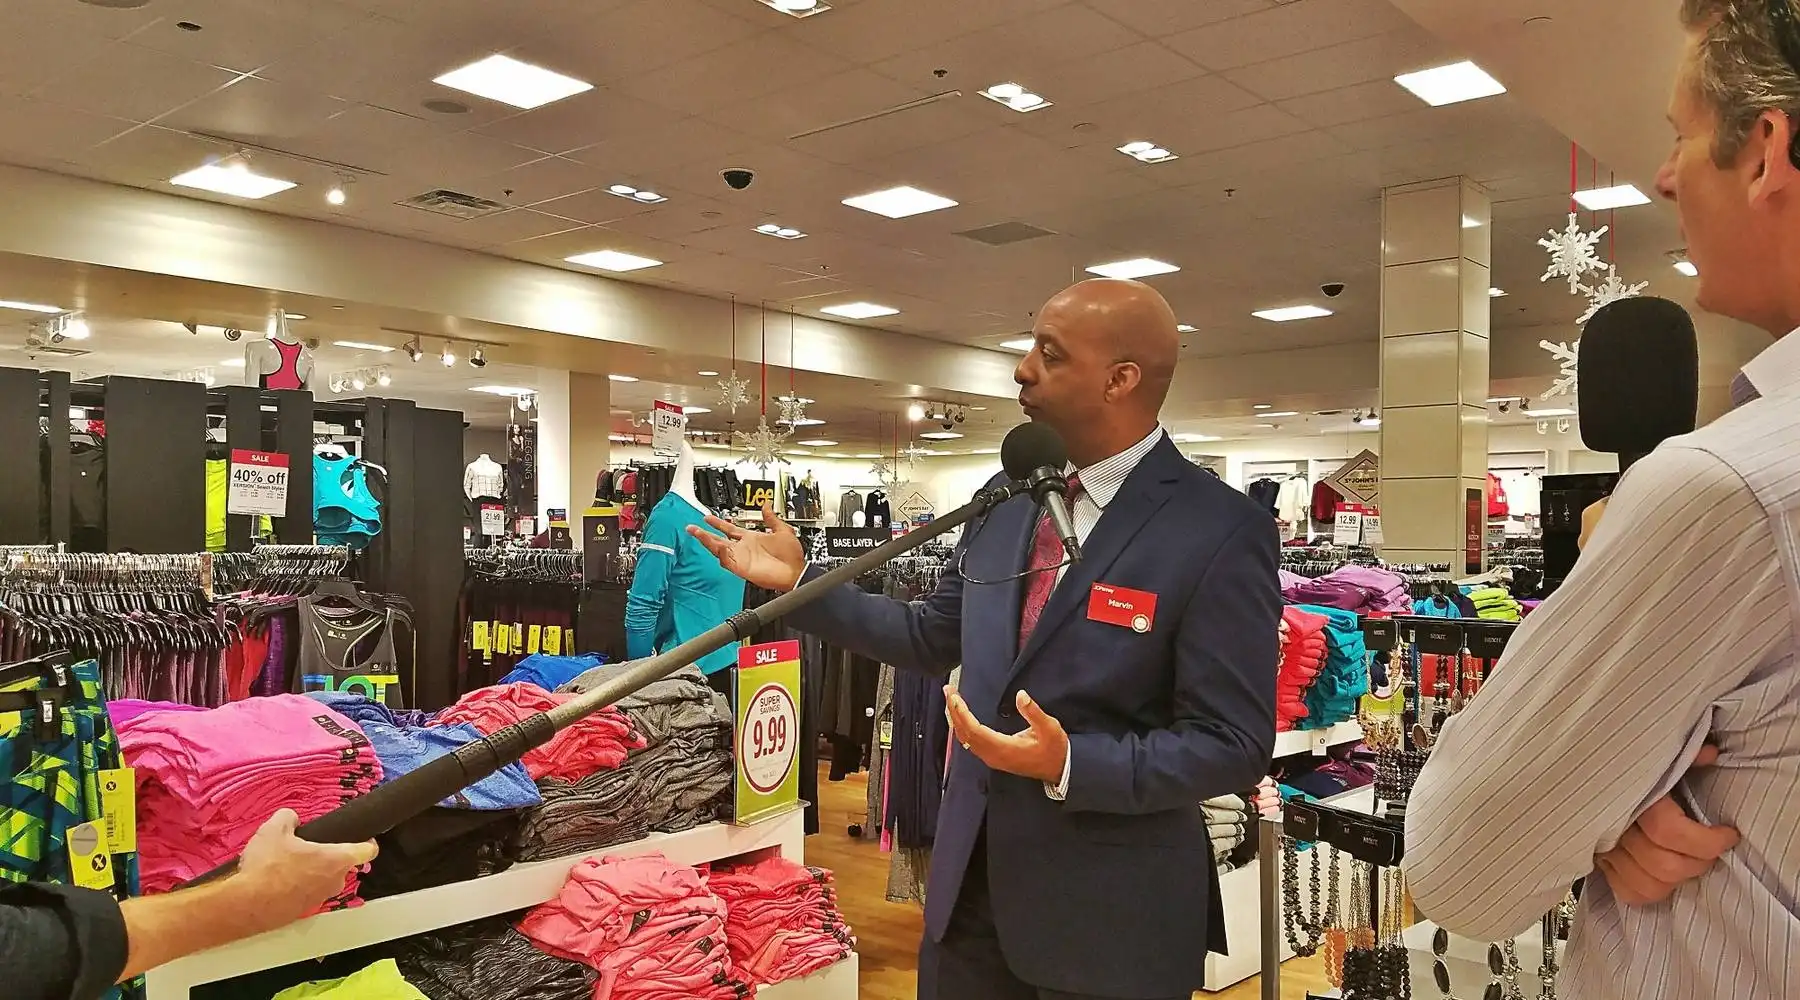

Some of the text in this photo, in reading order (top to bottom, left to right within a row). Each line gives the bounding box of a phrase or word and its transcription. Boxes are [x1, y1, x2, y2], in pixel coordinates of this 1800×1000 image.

[662, 415, 681, 428] 12.99
[251, 454, 269, 462] SALE
[525, 434, 533, 480] JEGGING
[234, 469, 286, 485] 40% off
[745, 484, 774, 506] Lee
[1339, 515, 1357, 525] 12.99
[833, 538, 873, 548] BASE LAYER
[1108, 599, 1134, 610] Marvin
[755, 648, 778, 664] SALE
[759, 694, 781, 707] SUPER
[753, 714, 787, 759] 9.99
